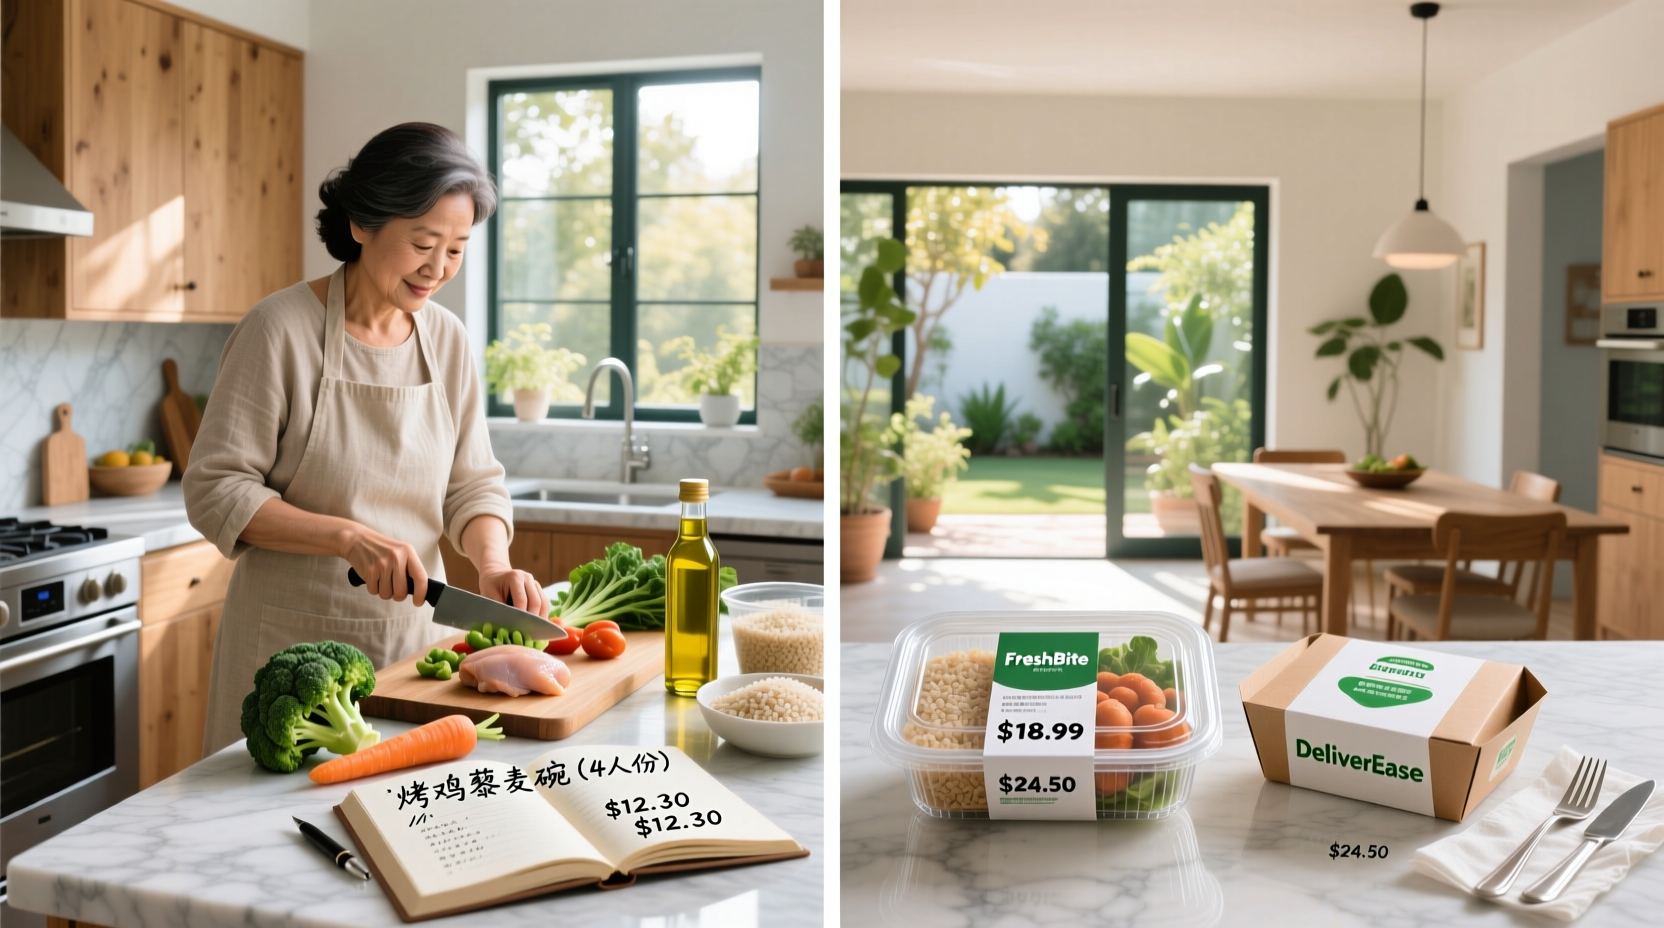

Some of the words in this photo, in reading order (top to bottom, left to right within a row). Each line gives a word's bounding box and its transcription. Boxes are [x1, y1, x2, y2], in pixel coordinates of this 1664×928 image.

[1005, 651, 1089, 666] FreshBite
[997, 719, 1084, 743] $18.99
[1295, 738, 1425, 783] DeliverEase
[999, 773, 1076, 795] $24.50
[605, 792, 690, 820] $12.30
[634, 810, 722, 838] $12.30
[1328, 841, 1389, 860] $24.50
